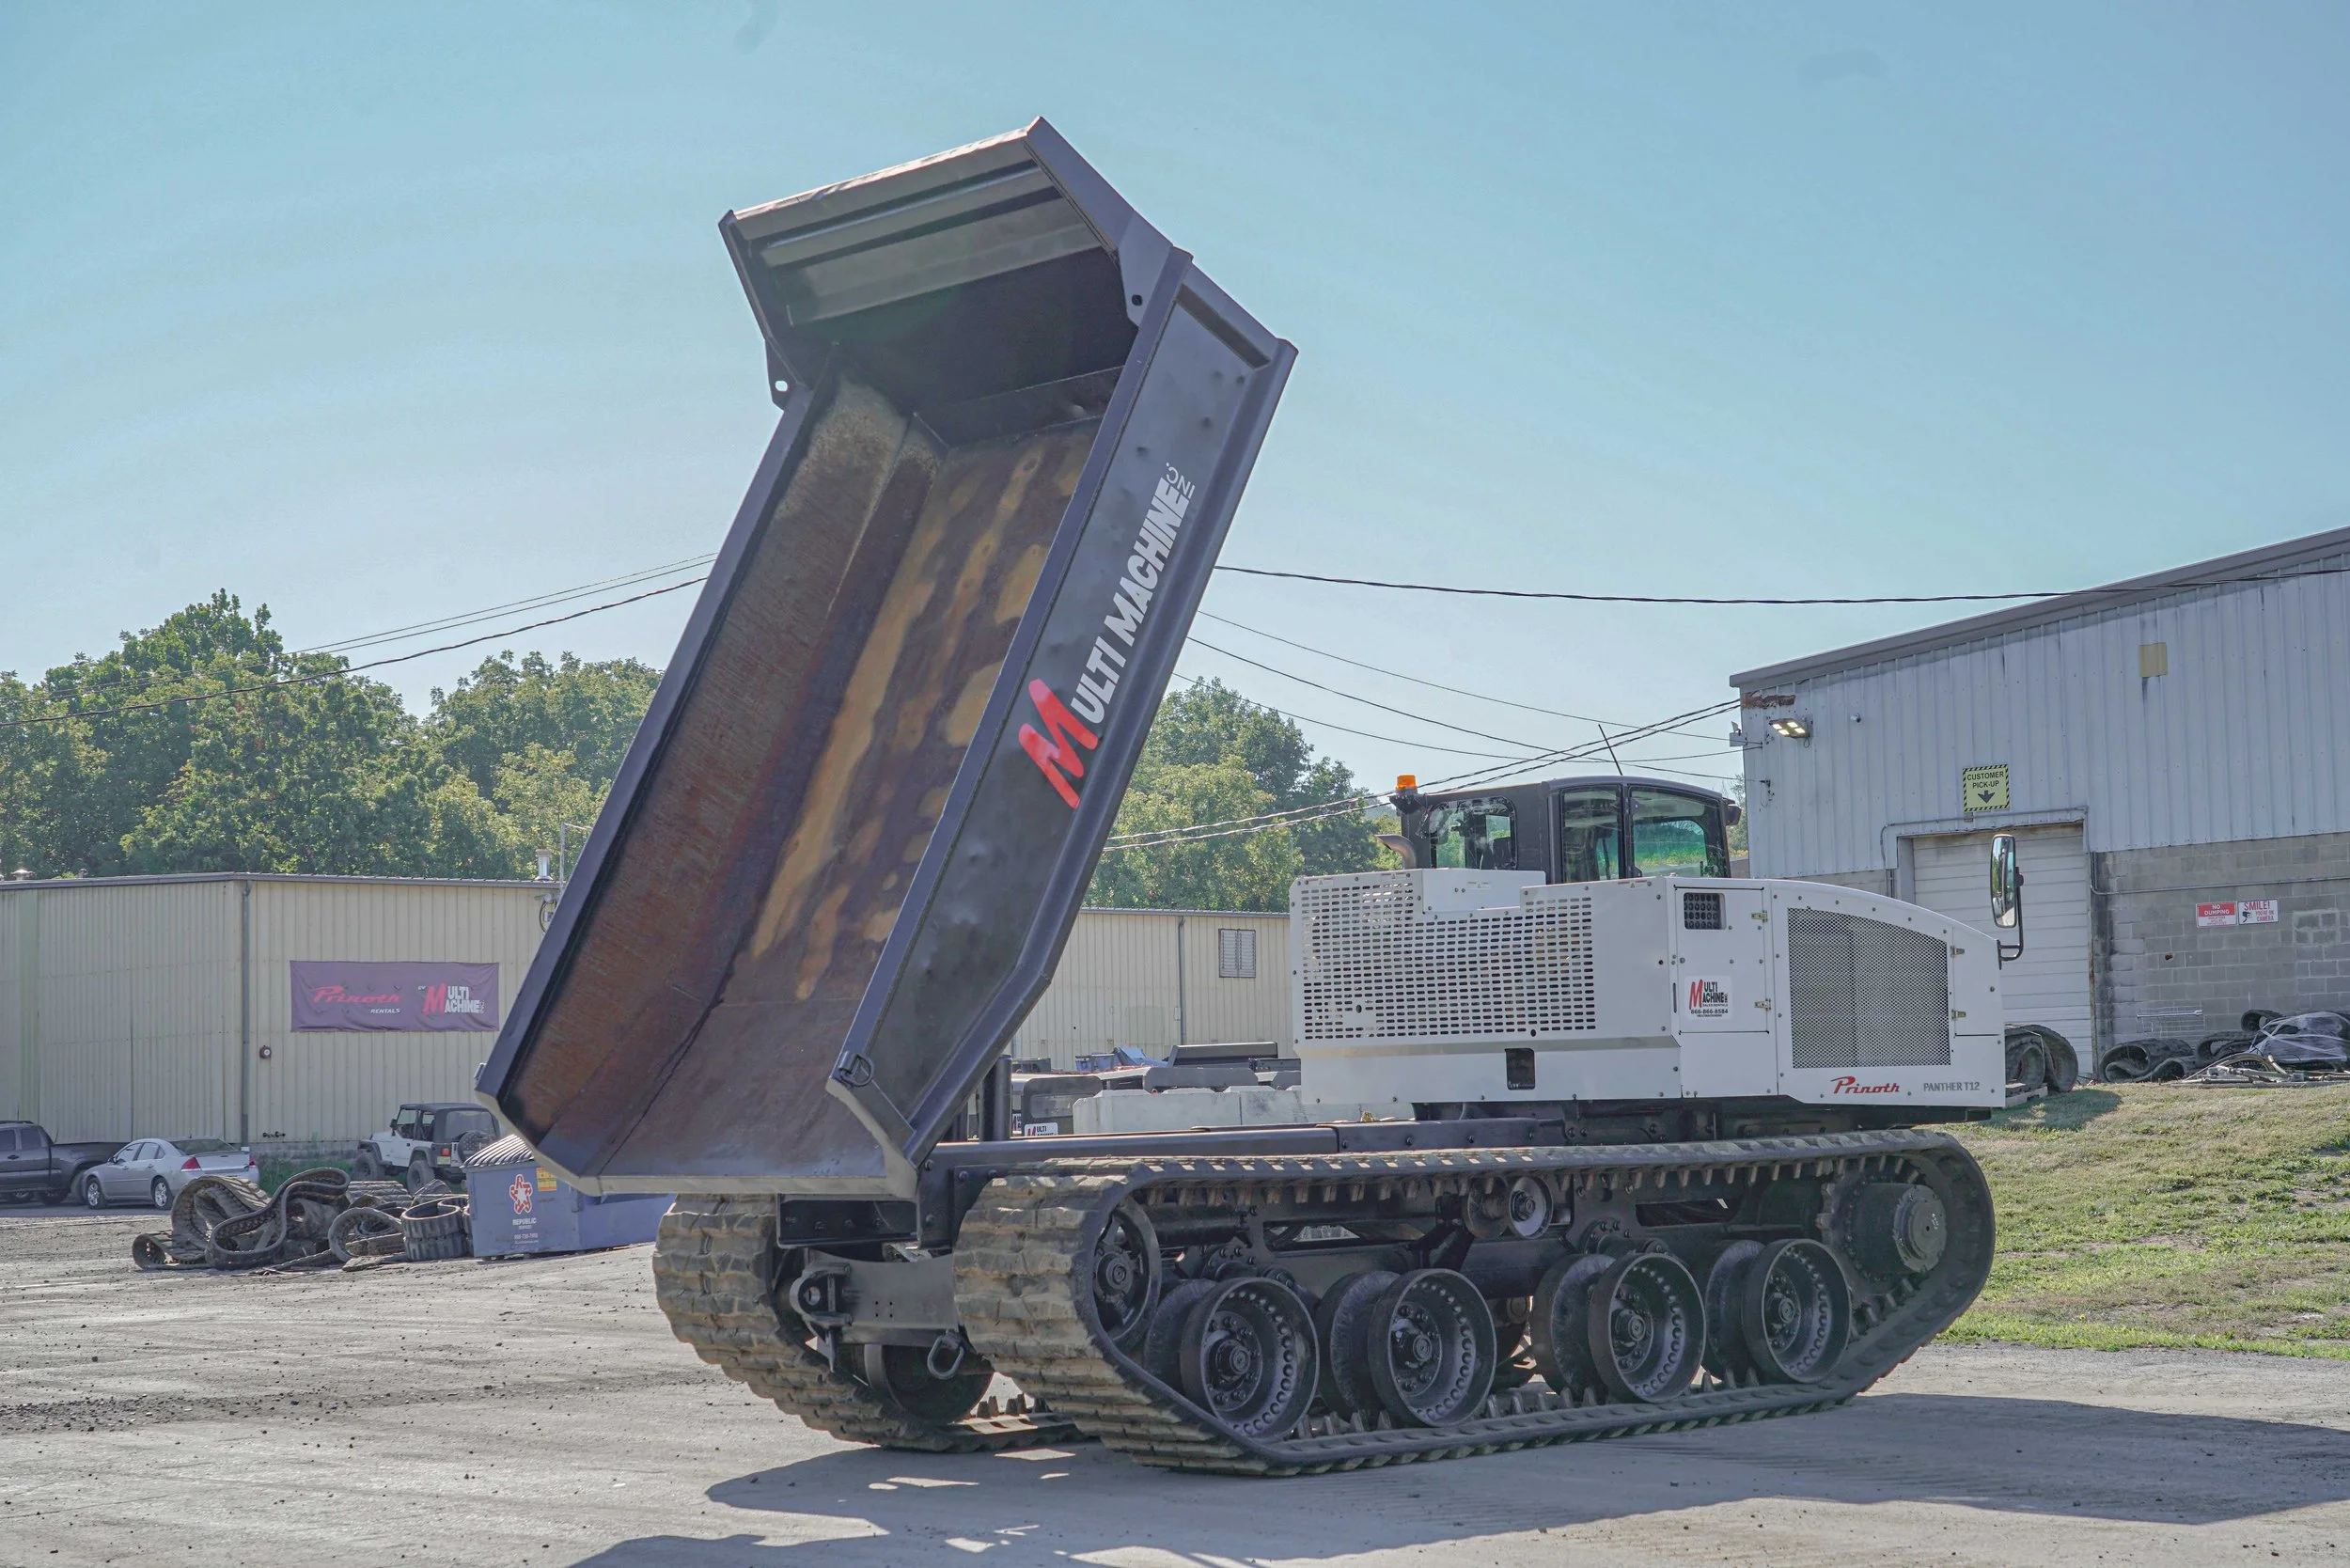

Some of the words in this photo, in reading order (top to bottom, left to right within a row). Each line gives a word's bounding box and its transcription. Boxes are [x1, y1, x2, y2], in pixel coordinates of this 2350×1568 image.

[1018, 636, 1126, 809] MULTI
[1104, 478, 1190, 647] MACHINE
[1966, 771, 2004, 780] CUSTOMER
[1972, 780, 1999, 789] PICK-UP
[2244, 902, 2270, 911] SMILE!
[311, 985, 400, 1003] Prinoth
[1830, 1075, 1901, 1094] Prinoth
[1923, 1082, 1963, 1091] PANTHER
[1965, 1082, 1980, 1090] T12
